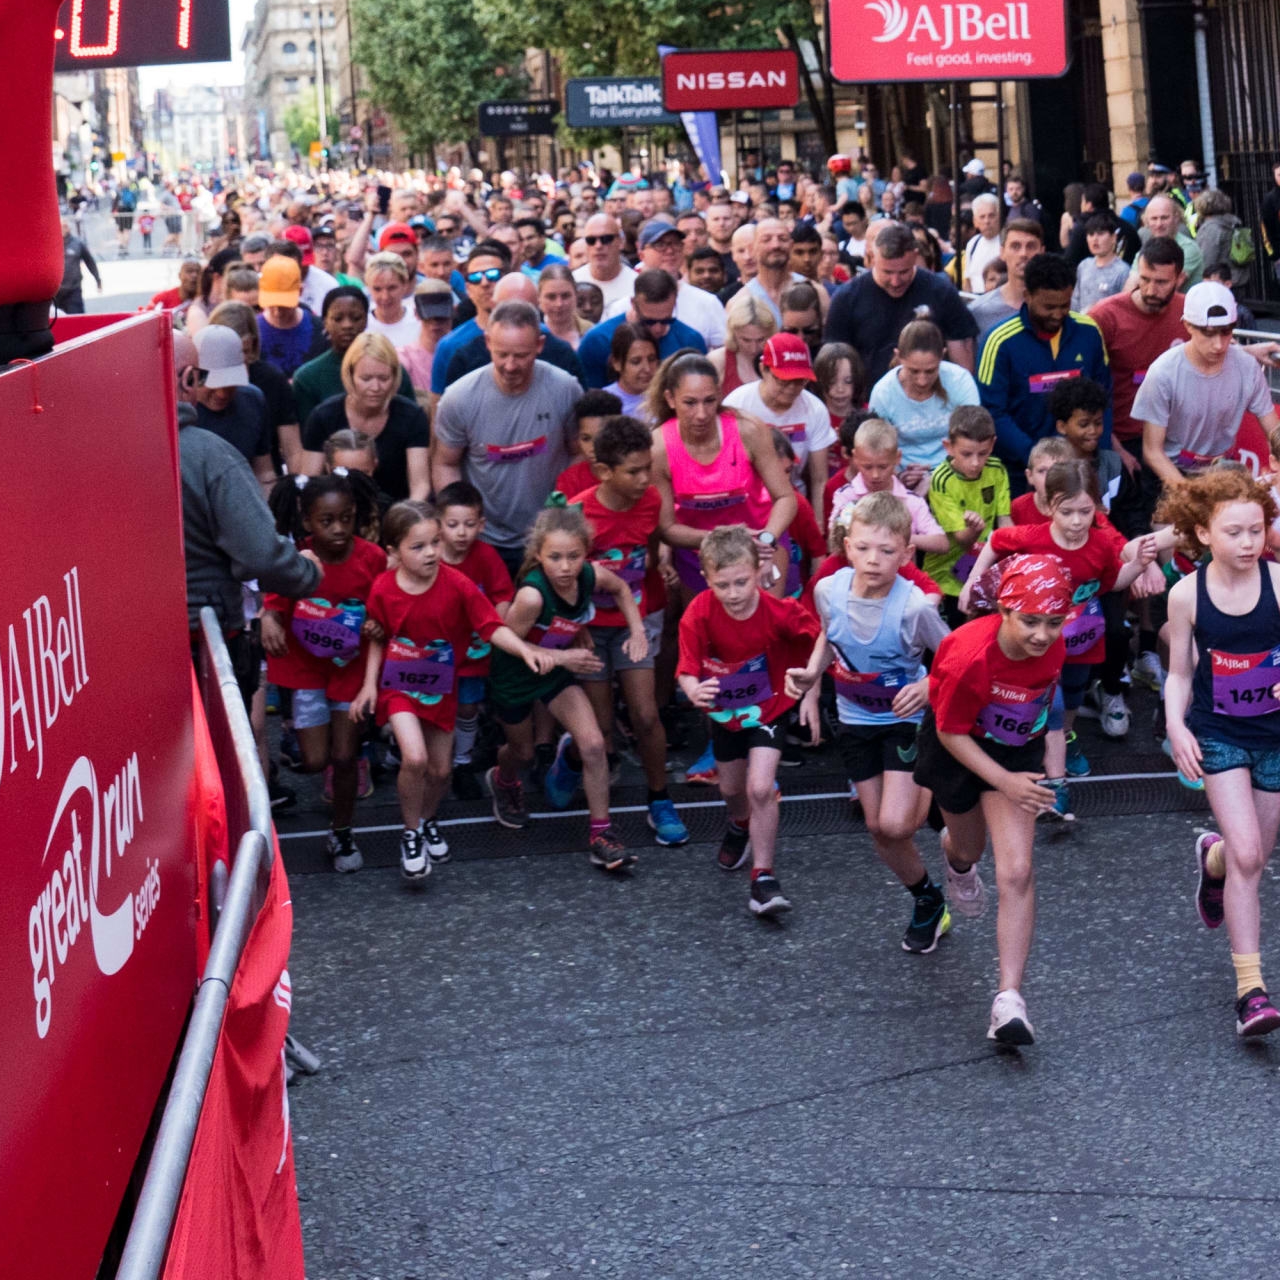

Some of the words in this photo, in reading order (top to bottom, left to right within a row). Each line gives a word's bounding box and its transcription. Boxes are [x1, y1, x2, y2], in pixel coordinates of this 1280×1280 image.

[906, 52, 933, 65] Feel
[676, 70, 787, 90] NISSAN
[584, 83, 662, 105] TalkTalk
[589, 106, 608, 118] For
[610, 105, 663, 120] Everyone
[302, 629, 345, 651] 1996
[397, 671, 440, 686] 1627
[103, 751, 144, 878] run
[134, 858, 161, 940] series
[28, 809, 89, 1039] great
